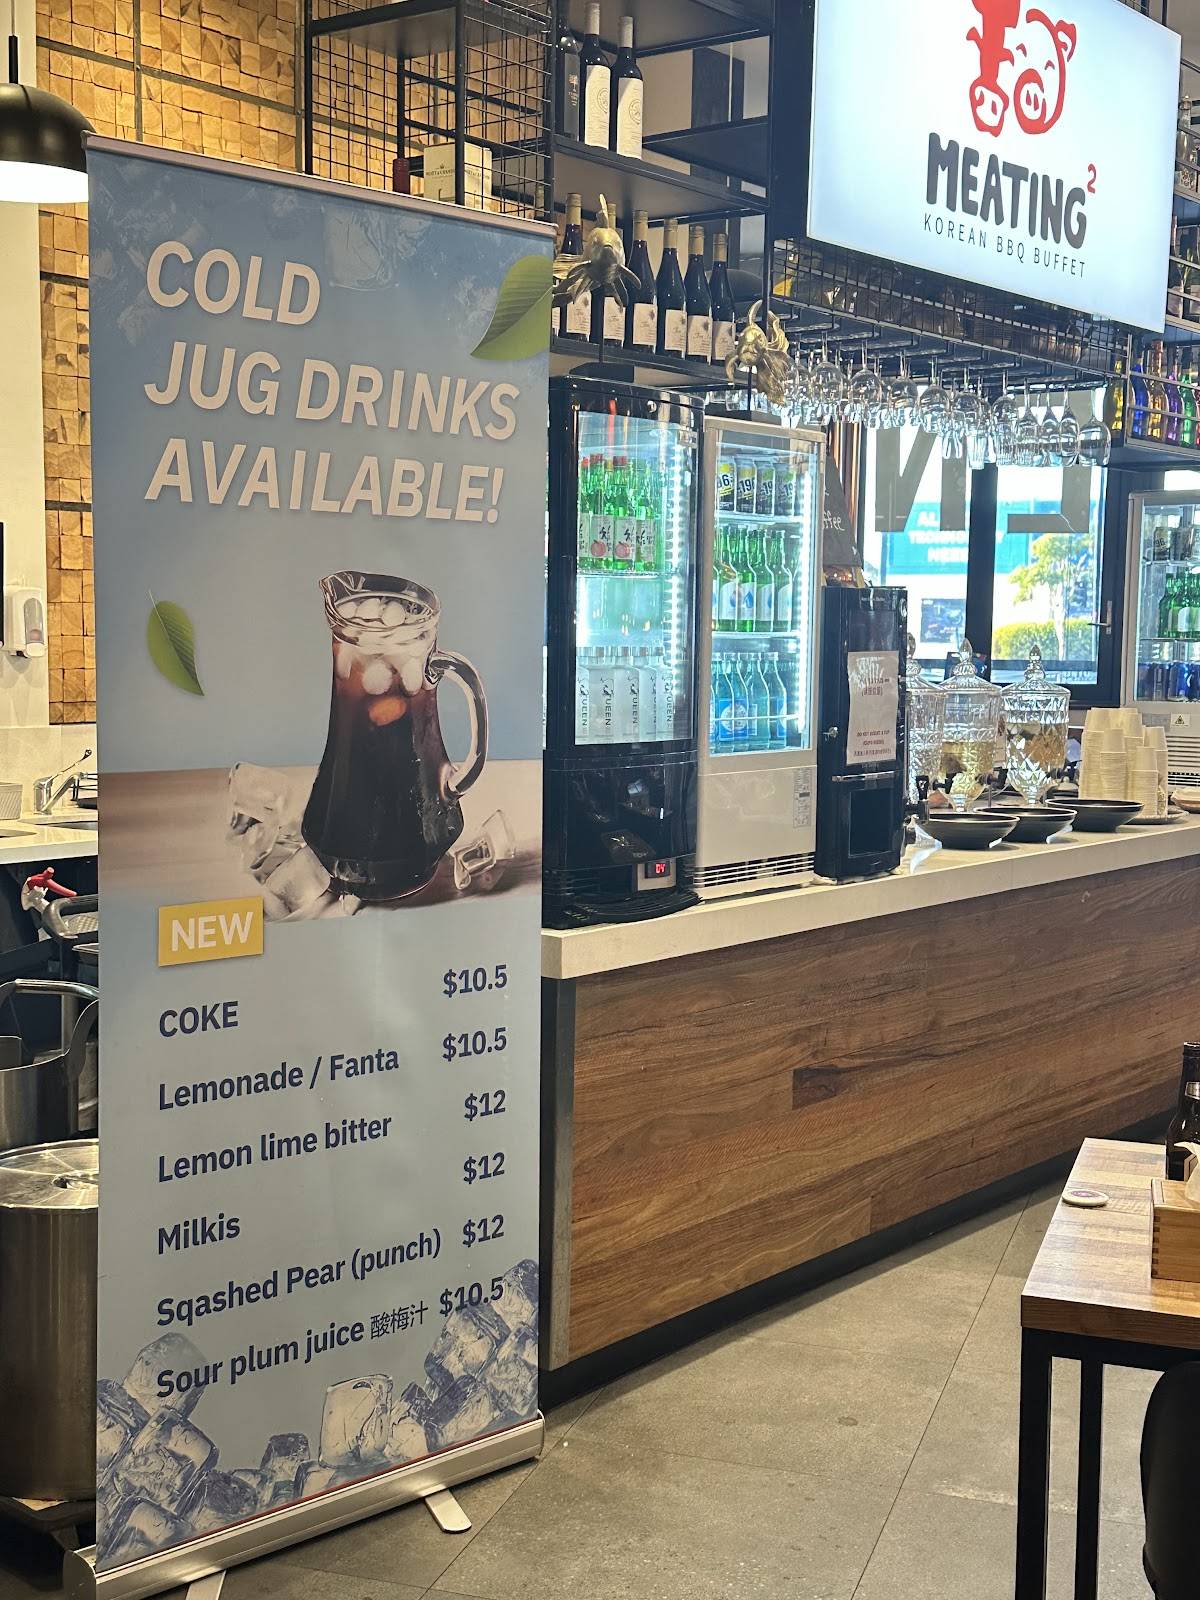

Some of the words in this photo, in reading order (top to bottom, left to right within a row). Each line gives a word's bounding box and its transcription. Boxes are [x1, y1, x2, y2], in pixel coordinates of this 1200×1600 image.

[926, 132, 1087, 249] MEATING
[924, 214, 987, 249] KOREAN
[996, 236, 1025, 262] BBQ
[1034, 248, 1085, 277] BUFFET
[146, 240, 320, 326] COLD
[144, 341, 281, 416] JUG
[296, 358, 520, 440] DRINKS
[144, 438, 504, 523] AVAILABLE!
[171, 911, 254, 952] NEW
[443, 964, 508, 998] $10.5
[159, 1001, 239, 1038] COKE
[442, 1027, 508, 1061] $10.5
[159, 1062, 304, 1111] Lemonade
[308, 1055, 323, 1089] /
[330, 1047, 399, 1081] Fanta
[464, 1089, 506, 1121] $12
[159, 1143, 252, 1182] Lemon
[260, 1130, 317, 1162] lime
[325, 1114, 393, 1150] bitter
[463, 1152, 505, 1184] $12
[158, 1212, 241, 1255] Milkis
[462, 1215, 505, 1248] $12
[157, 1271, 278, 1330] Sqashed
[287, 1255, 346, 1295] Pear
[351, 1228, 441, 1279] (punch)
[439, 1276, 504, 1318] $10.5
[157, 1358, 223, 1398] Sour
[230, 1338, 299, 1382] plum
[304, 1315, 364, 1363] juice
[370, 1300, 429, 1340] 酸梅汁
